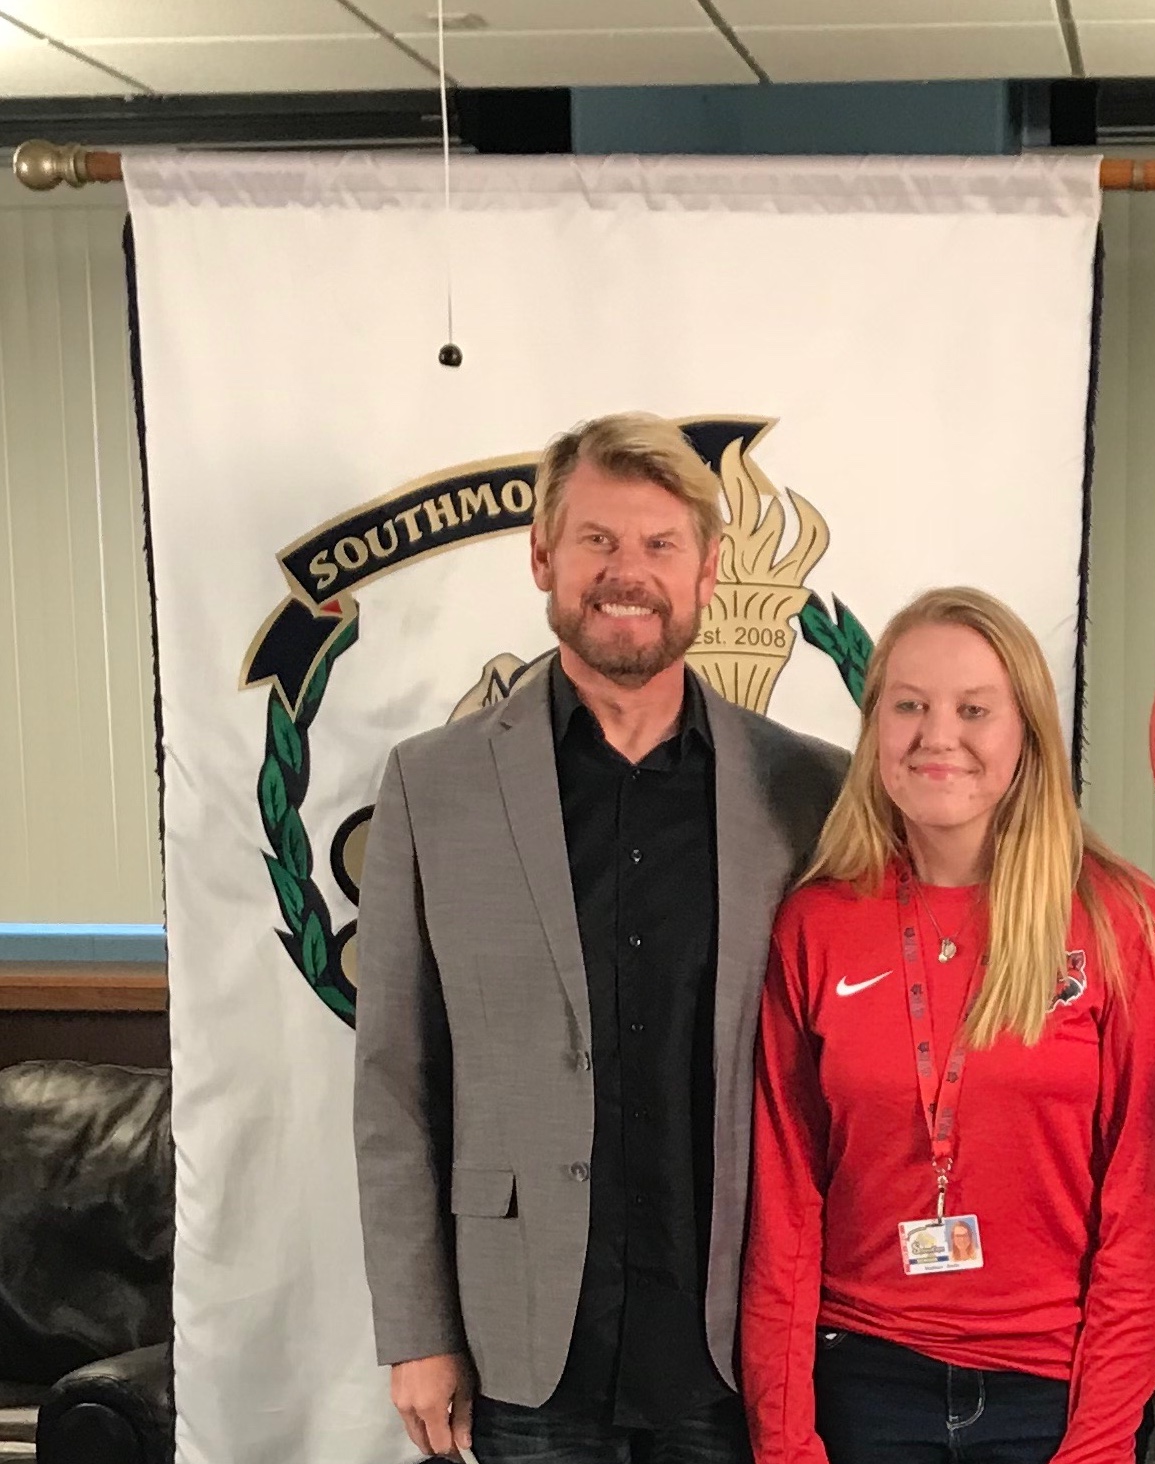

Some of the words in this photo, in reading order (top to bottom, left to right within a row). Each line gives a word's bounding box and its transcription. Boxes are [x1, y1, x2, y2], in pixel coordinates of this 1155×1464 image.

[309, 479, 536, 590] SOUTHMO
[694, 627, 726, 645] st.
[735, 626, 786, 648] 2008
